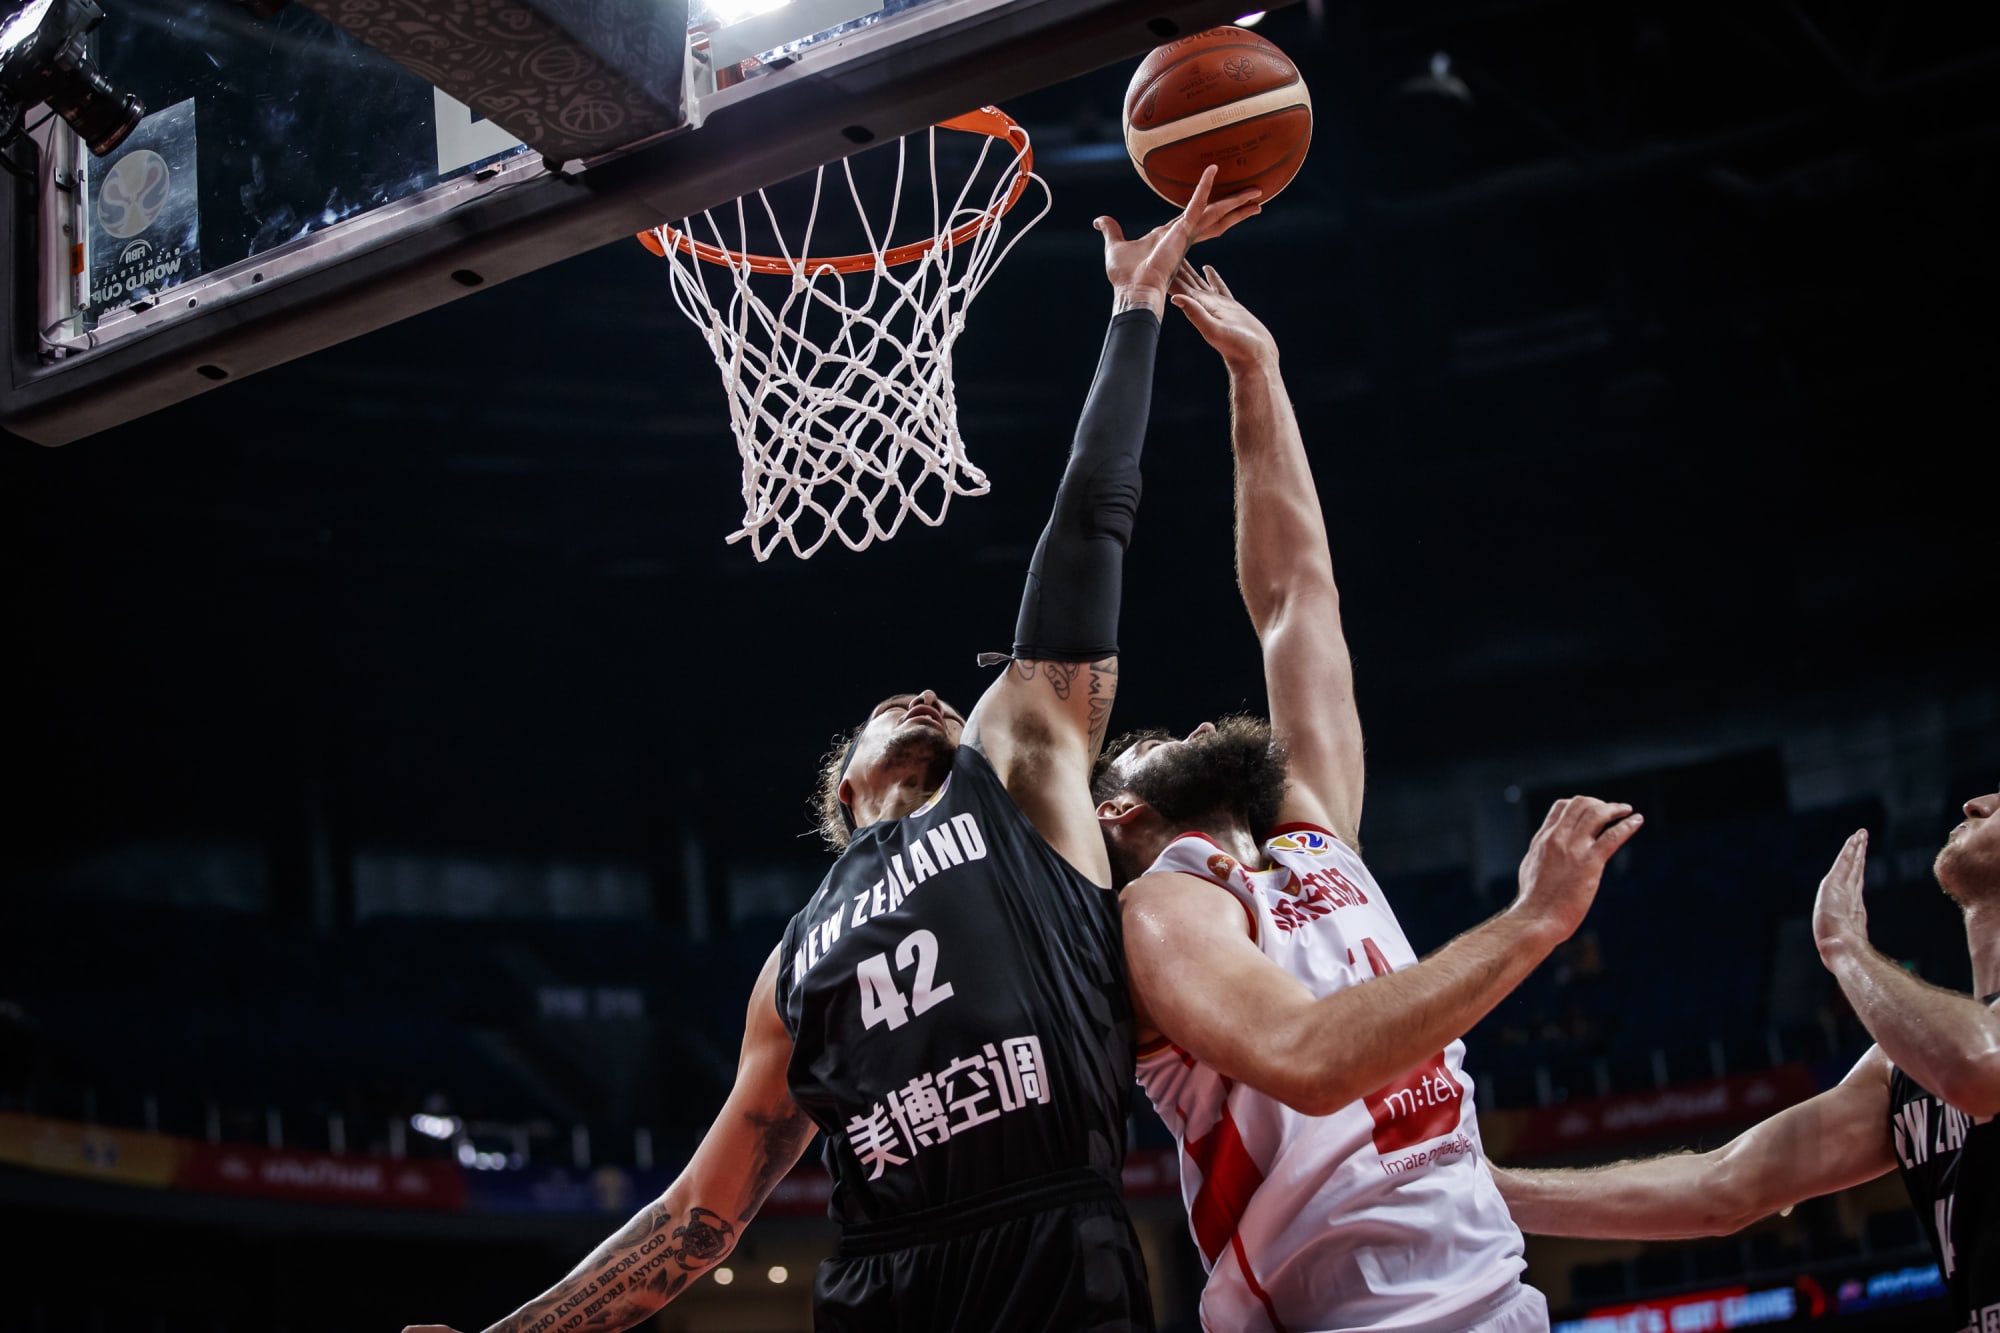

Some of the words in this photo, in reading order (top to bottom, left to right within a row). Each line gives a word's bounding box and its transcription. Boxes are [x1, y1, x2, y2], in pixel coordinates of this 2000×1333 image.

[793, 906, 844, 985] NEW
[850, 812, 987, 929] ZEALAND
[856, 929, 954, 1032] 42
[846, 1035, 1052, 1182] 美博空调
[1383, 1066, 1458, 1120] m:tel
[1380, 1150, 1427, 1176] Imate
[553, 1314, 583, 1333] AND
[584, 1282, 627, 1317] BEFORE
[626, 1245, 676, 1288] ANYONE
[555, 1282, 599, 1319] KNEELS
[596, 1252, 641, 1287] BEFORE
[640, 1233, 666, 1255] GOD
